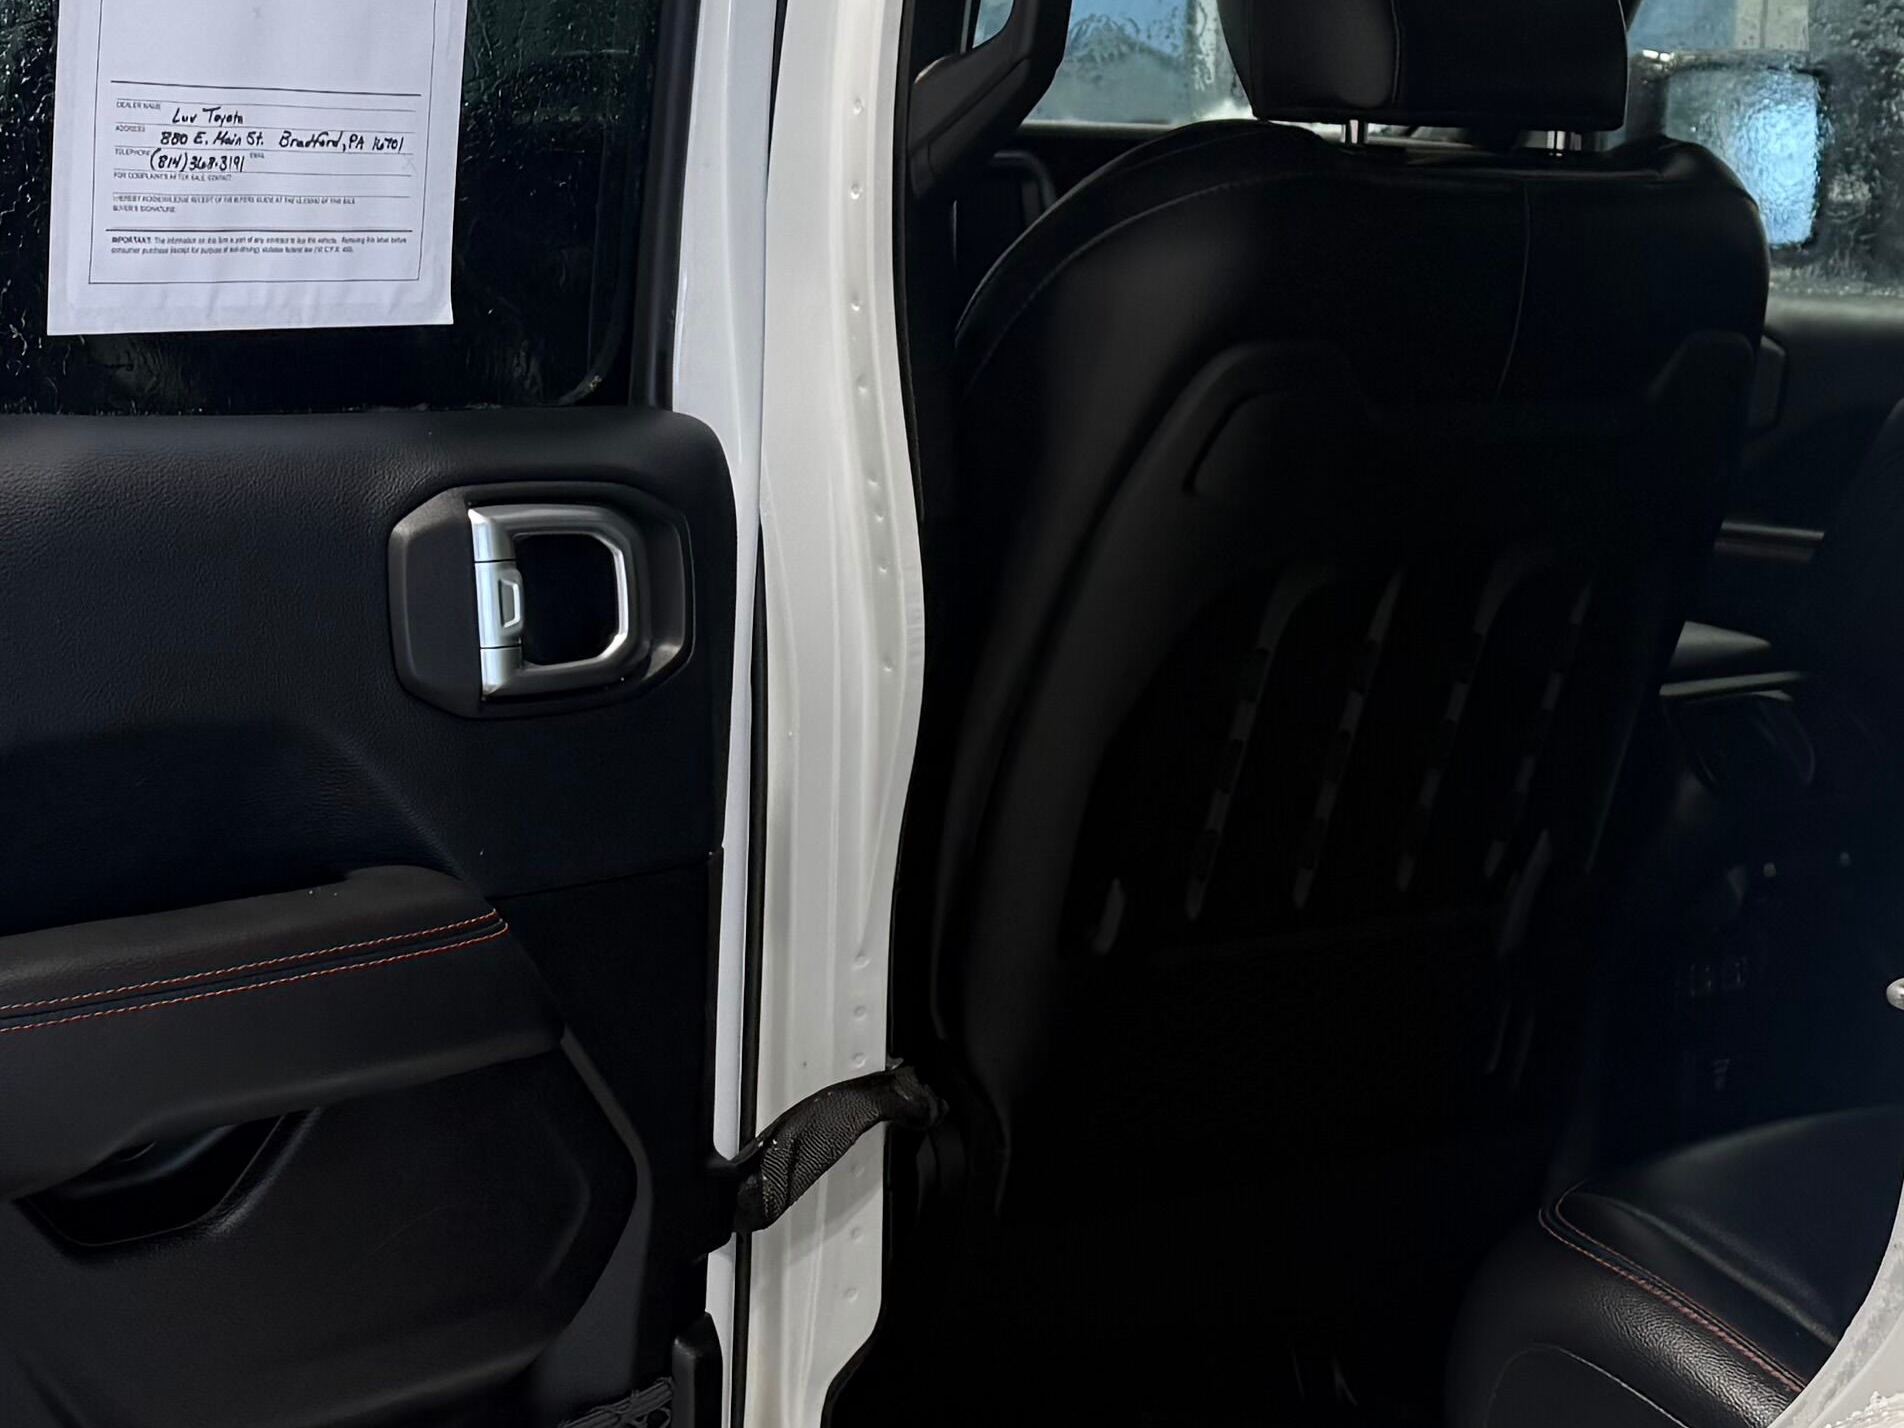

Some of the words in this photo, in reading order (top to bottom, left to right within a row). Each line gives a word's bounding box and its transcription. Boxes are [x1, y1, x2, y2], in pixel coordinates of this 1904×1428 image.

[172, 107, 197, 124] Luv
[202, 106, 244, 128] Toyota
[160, 130, 189, 146] 880
[212, 130, 242, 146] Main
[348, 133, 365, 151] PA
